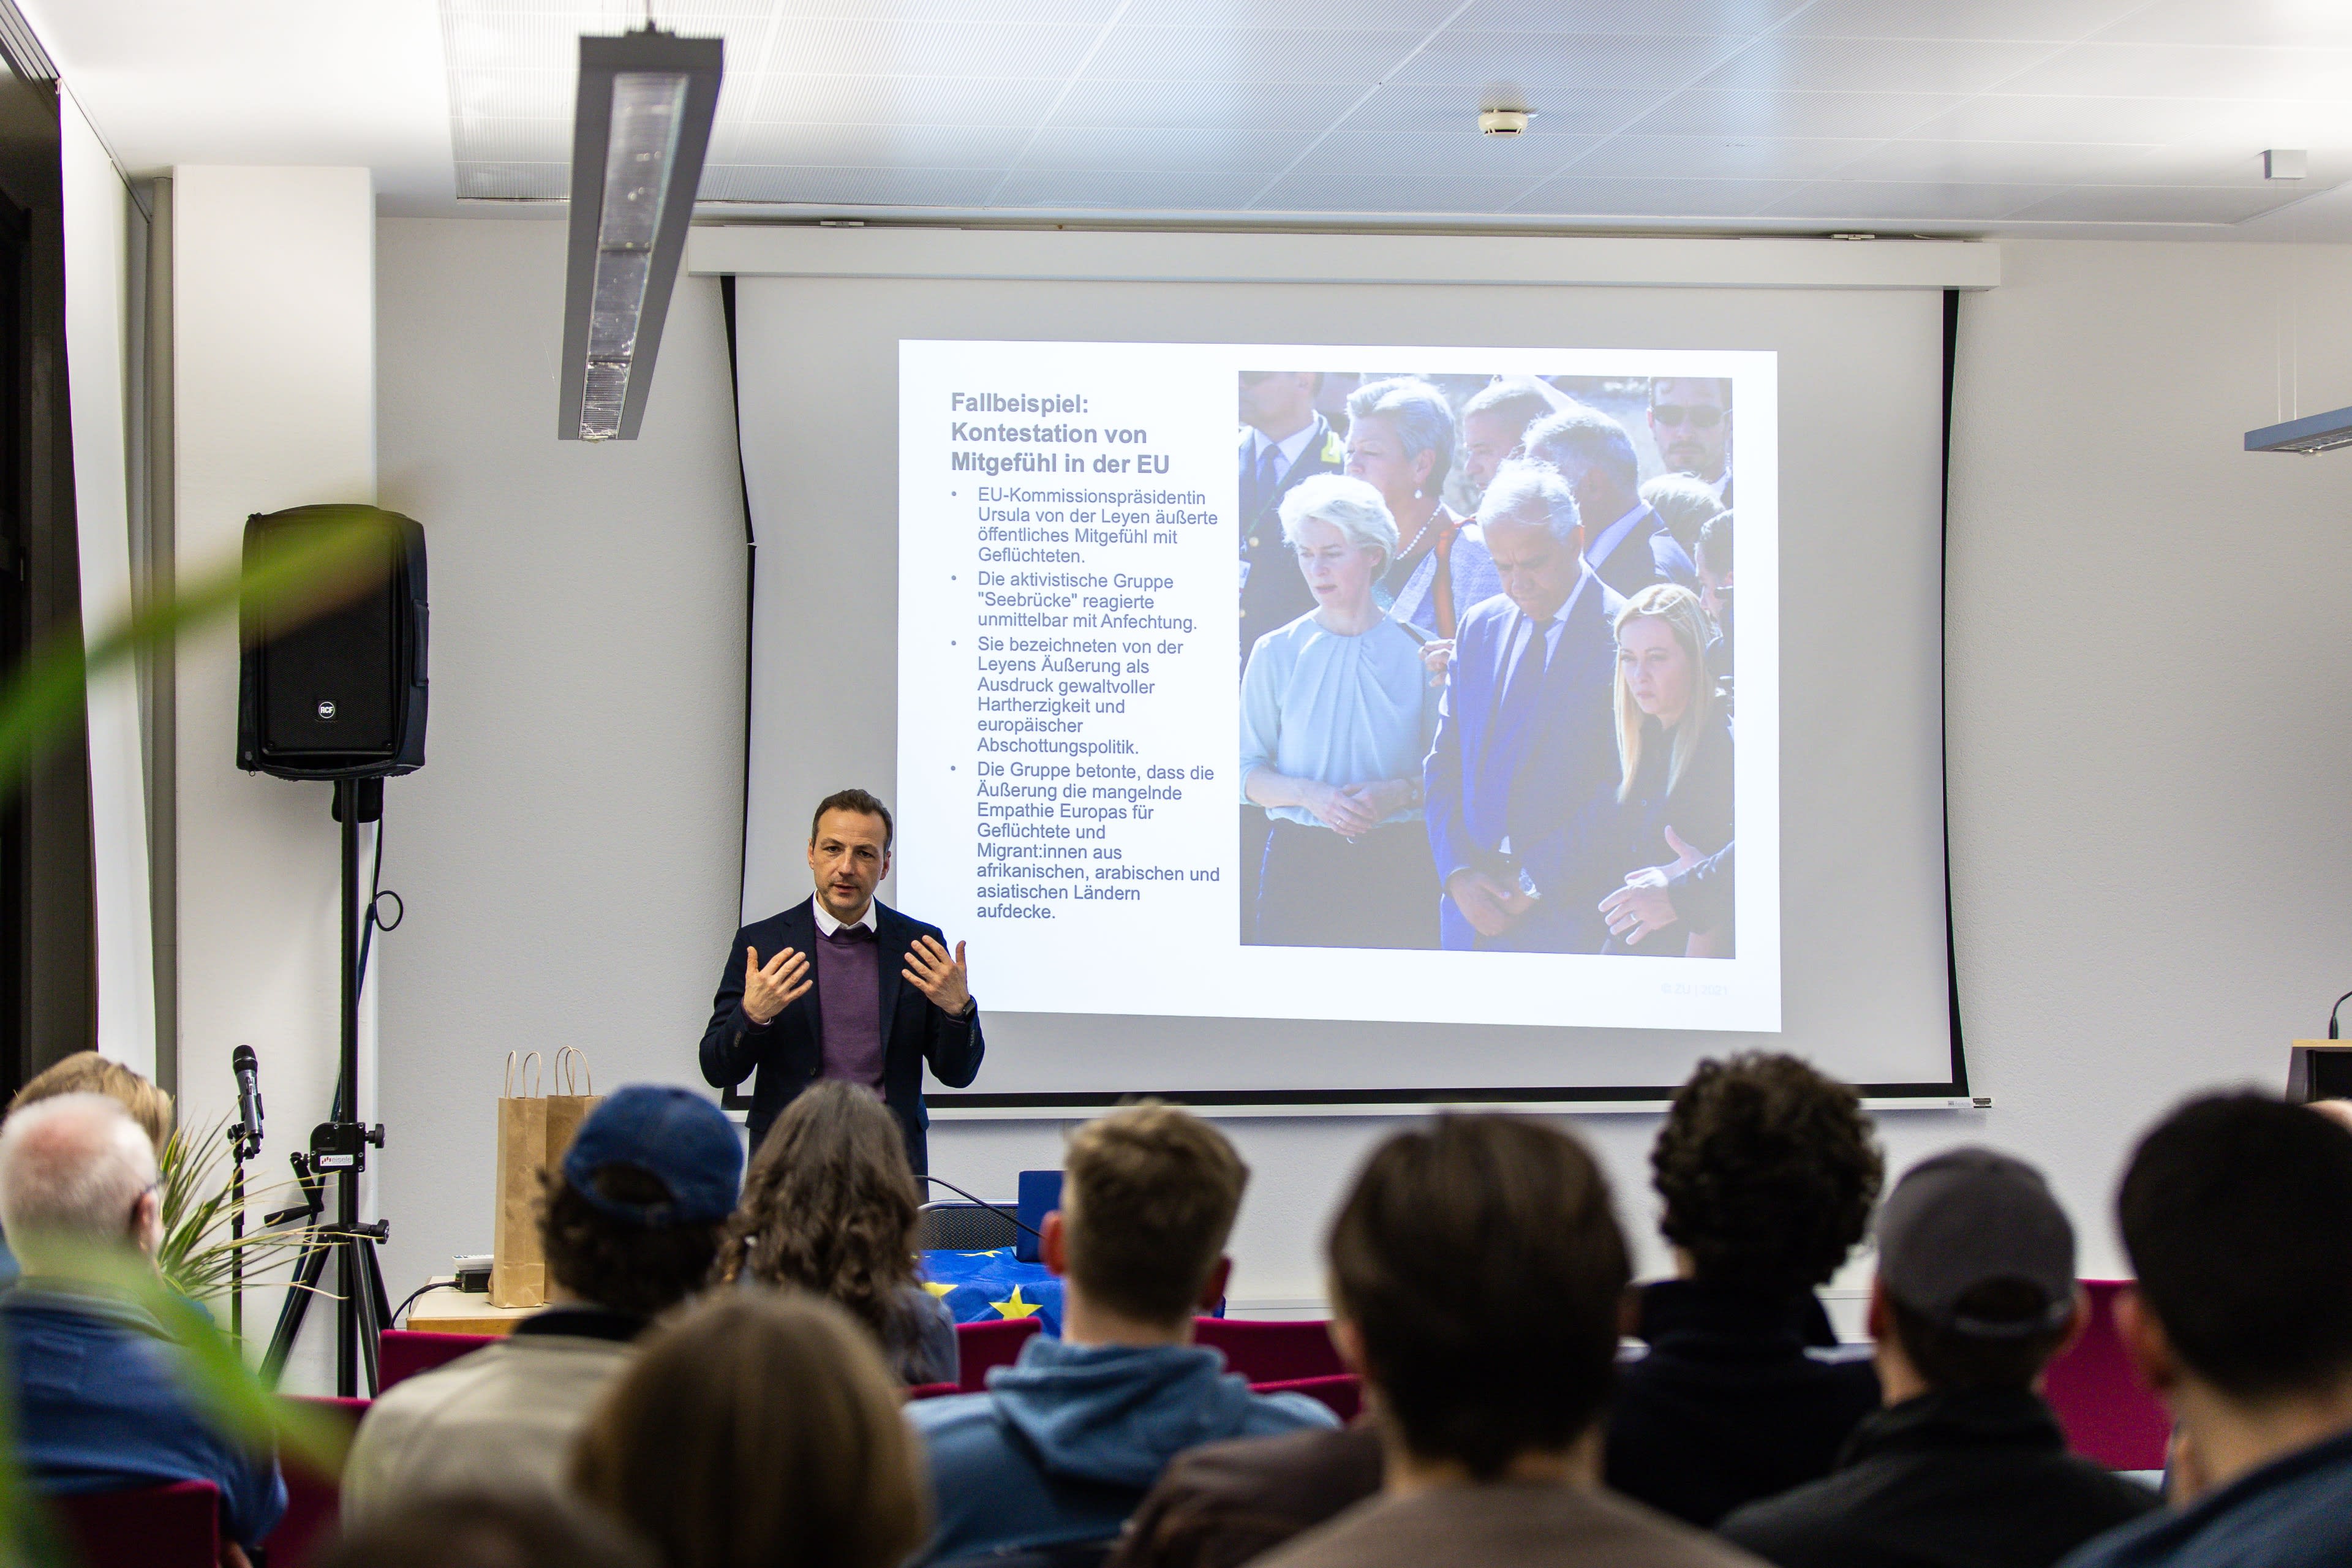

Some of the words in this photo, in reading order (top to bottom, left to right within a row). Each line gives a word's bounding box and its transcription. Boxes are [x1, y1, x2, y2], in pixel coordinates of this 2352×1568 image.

[951, 392, 1088, 418] Fallbeispiel:
[951, 421, 1098, 443] Kontestation
[1104, 429, 1147, 444] von
[951, 451, 1057, 477] Mitgefühl
[1065, 453, 1085, 473] in
[1092, 453, 1131, 473] der
[1137, 454, 1169, 474] EU
[978, 486, 1205, 508] EU-Kommissionspräsidentin
[978, 506, 1030, 522] Ursula
[1035, 510, 1064, 522] von
[1069, 508, 1097, 523] der
[1101, 508, 1150, 527] Leyen
[1155, 509, 1218, 525] äußerte
[978, 526, 1069, 543] öffentliches
[1074, 527, 1147, 547] Mitgefühl
[1153, 529, 1178, 545] mit
[978, 546, 1085, 564] Geflüchteten.
[978, 570, 1005, 586] Die
[1010, 571, 1108, 588] aktivistische
[1113, 573, 1174, 593] Gruppe
[978, 591, 1077, 608] "Seebrücke"
[1083, 594, 1155, 612] reagierte
[978, 611, 1069, 628] unmittelbar
[1072, 612, 1098, 628] mit
[1099, 612, 1197, 633] Anfechtung.
[978, 636, 1005, 652] Sie
[1009, 636, 1117, 654] bezeichneten
[1121, 642, 1152, 654] von
[1156, 639, 1184, 655] der
[978, 655, 1036, 675] Leyens
[1041, 654, 1121, 677] Äußerung
[1126, 658, 1150, 674] als
[976, 676, 1054, 693] Ausdruck
[1058, 678, 1156, 696] gewaltvoller
[978, 696, 1091, 717] Hartherzigkeit
[1095, 698, 1125, 714] und
[977, 717, 1084, 736] europäischer
[976, 736, 1139, 758] Abschottungspolitik.
[978, 761, 1005, 777] Die
[1010, 761, 1071, 782] Gruppe
[1076, 762, 1140, 782] betonte,
[1146, 764, 1185, 780] dass
[1189, 764, 1215, 780] die
[976, 779, 1057, 802] Äußerung
[1062, 783, 1087, 799] die
[1092, 784, 1183, 804] mangelnde
[977, 801, 1055, 821] Empathie
[1060, 802, 1128, 823] Europas
[1131, 804, 1155, 820] für
[977, 822, 1071, 839] Geflüchtete
[1076, 824, 1106, 840] und
[977, 842, 1088, 862] Migrant:innen
[1092, 848, 1123, 860] aus
[976, 862, 1090, 882] afrikanischen,
[1095, 864, 1184, 881] arabischen
[1189, 867, 1220, 882] und
[976, 883, 1068, 900] asiatischen
[1074, 884, 1140, 901] Ländern
[976, 902, 1056, 919] aufdecke.
[1674, 983, 1691, 995] ZU
[1700, 984, 1728, 996] 2021
